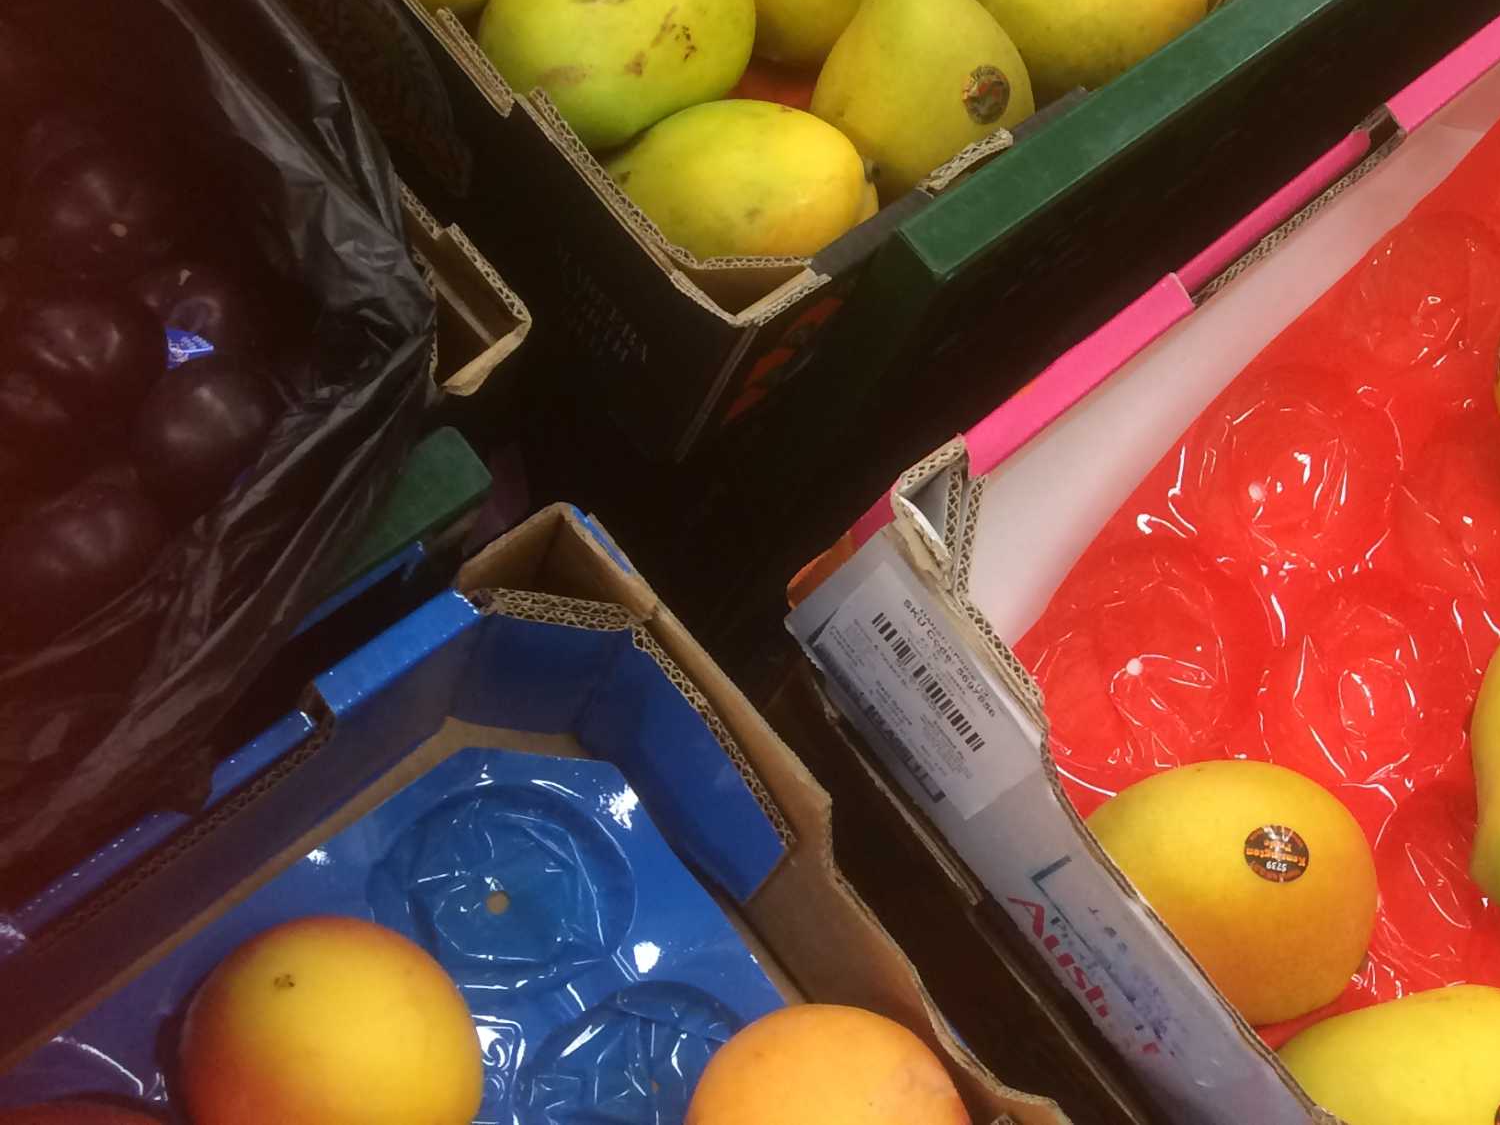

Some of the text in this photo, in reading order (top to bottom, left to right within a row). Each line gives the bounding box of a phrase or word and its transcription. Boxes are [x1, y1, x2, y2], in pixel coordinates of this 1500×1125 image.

[903, 598, 928, 627] SKU
[1246, 847, 1307, 868] Kensington
[1265, 860, 1288, 873] 5739
